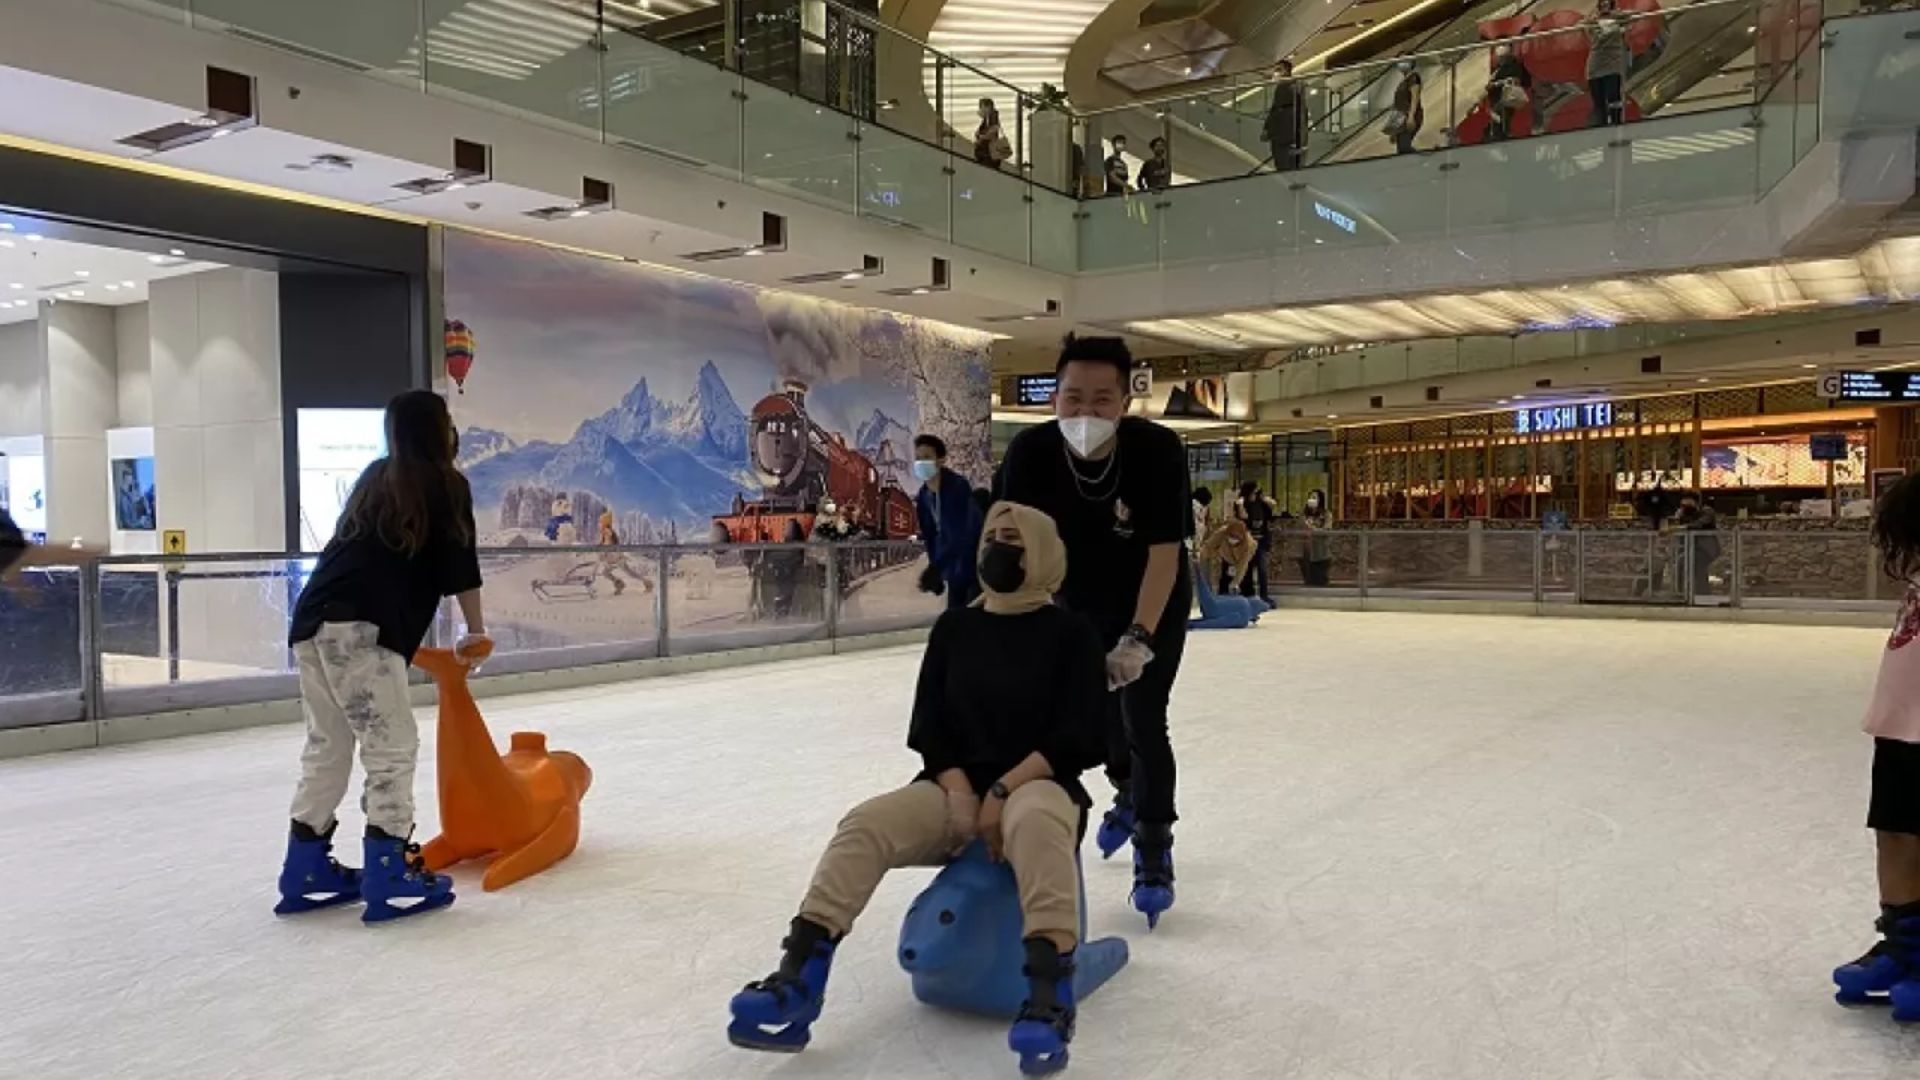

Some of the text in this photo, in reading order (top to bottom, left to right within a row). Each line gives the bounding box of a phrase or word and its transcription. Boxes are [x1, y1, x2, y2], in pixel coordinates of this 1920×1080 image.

[1133, 373, 1148, 393] G
[1824, 376, 1837, 394] G
[1535, 406, 1577, 430] SUSHI
[1585, 403, 1611, 426] TEI
